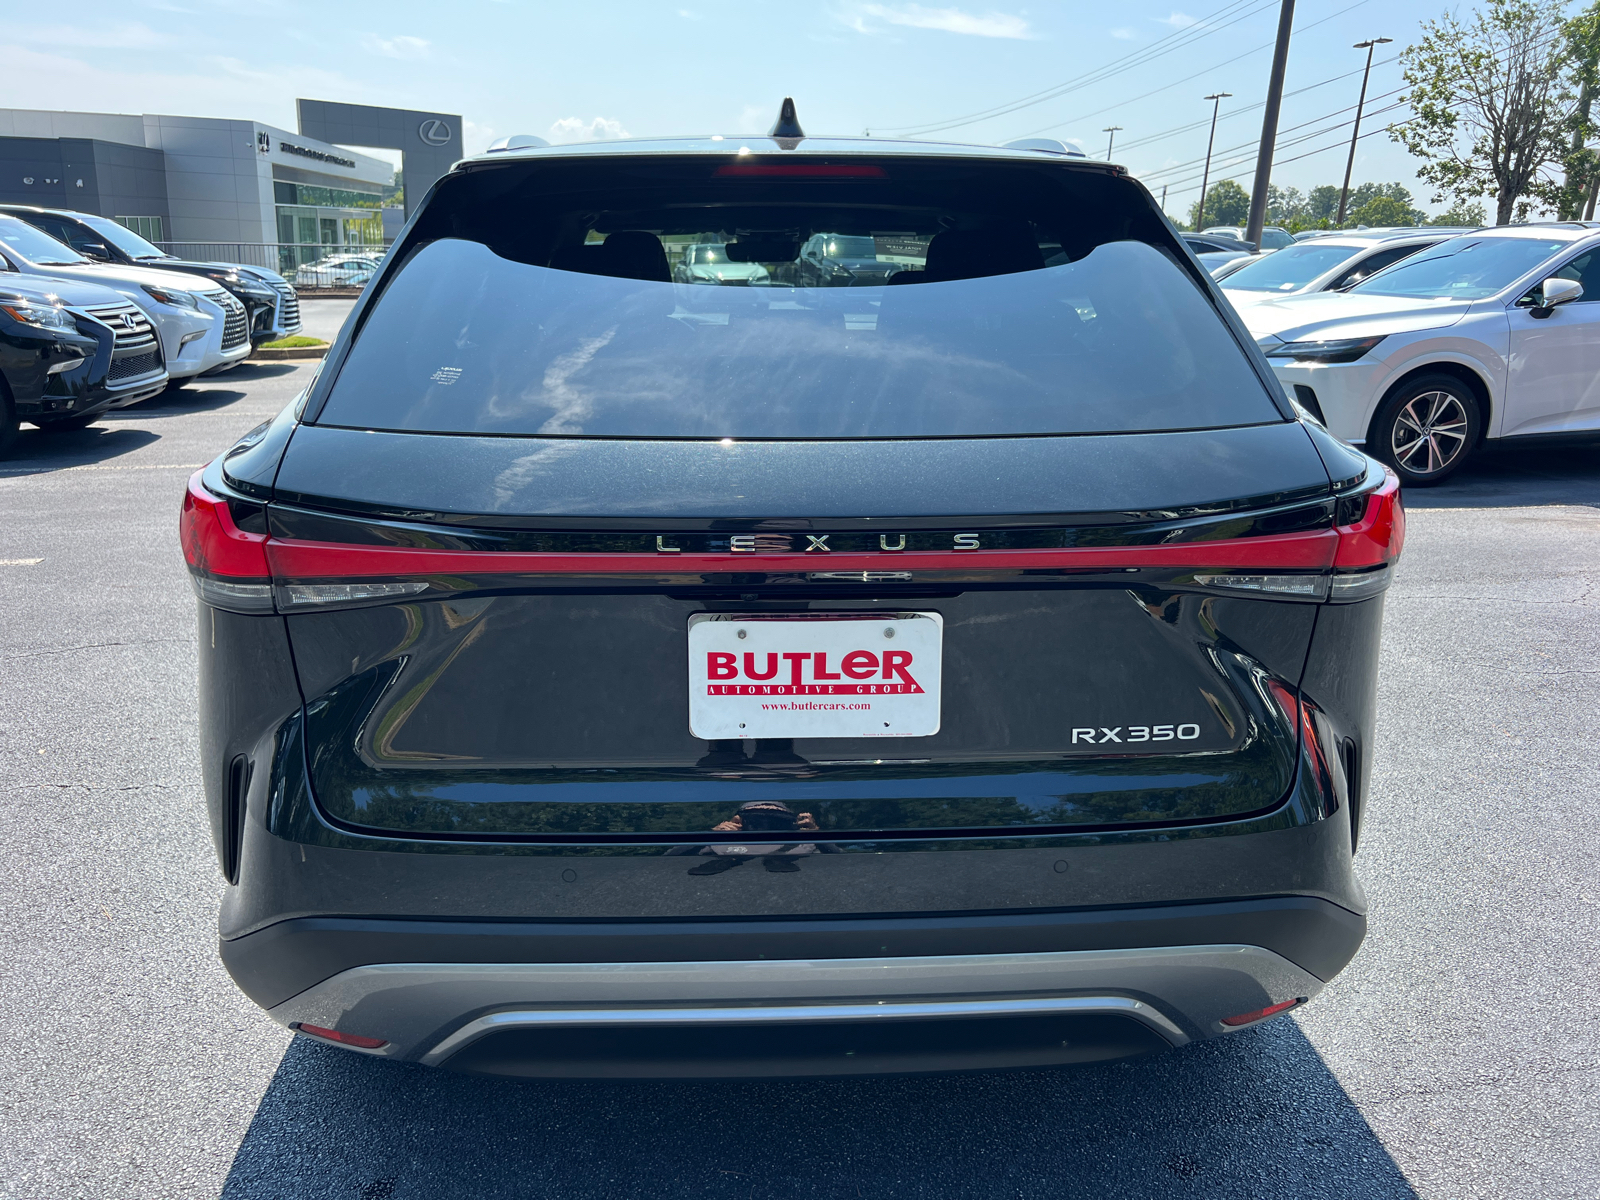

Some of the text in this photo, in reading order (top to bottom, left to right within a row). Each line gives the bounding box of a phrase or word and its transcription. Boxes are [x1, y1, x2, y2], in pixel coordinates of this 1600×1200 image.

[656, 534, 980, 551] LEXUS
[708, 684, 918, 695] AUTOMOTIVE GROUP
[761, 701, 872, 712] www.butlercars.com
